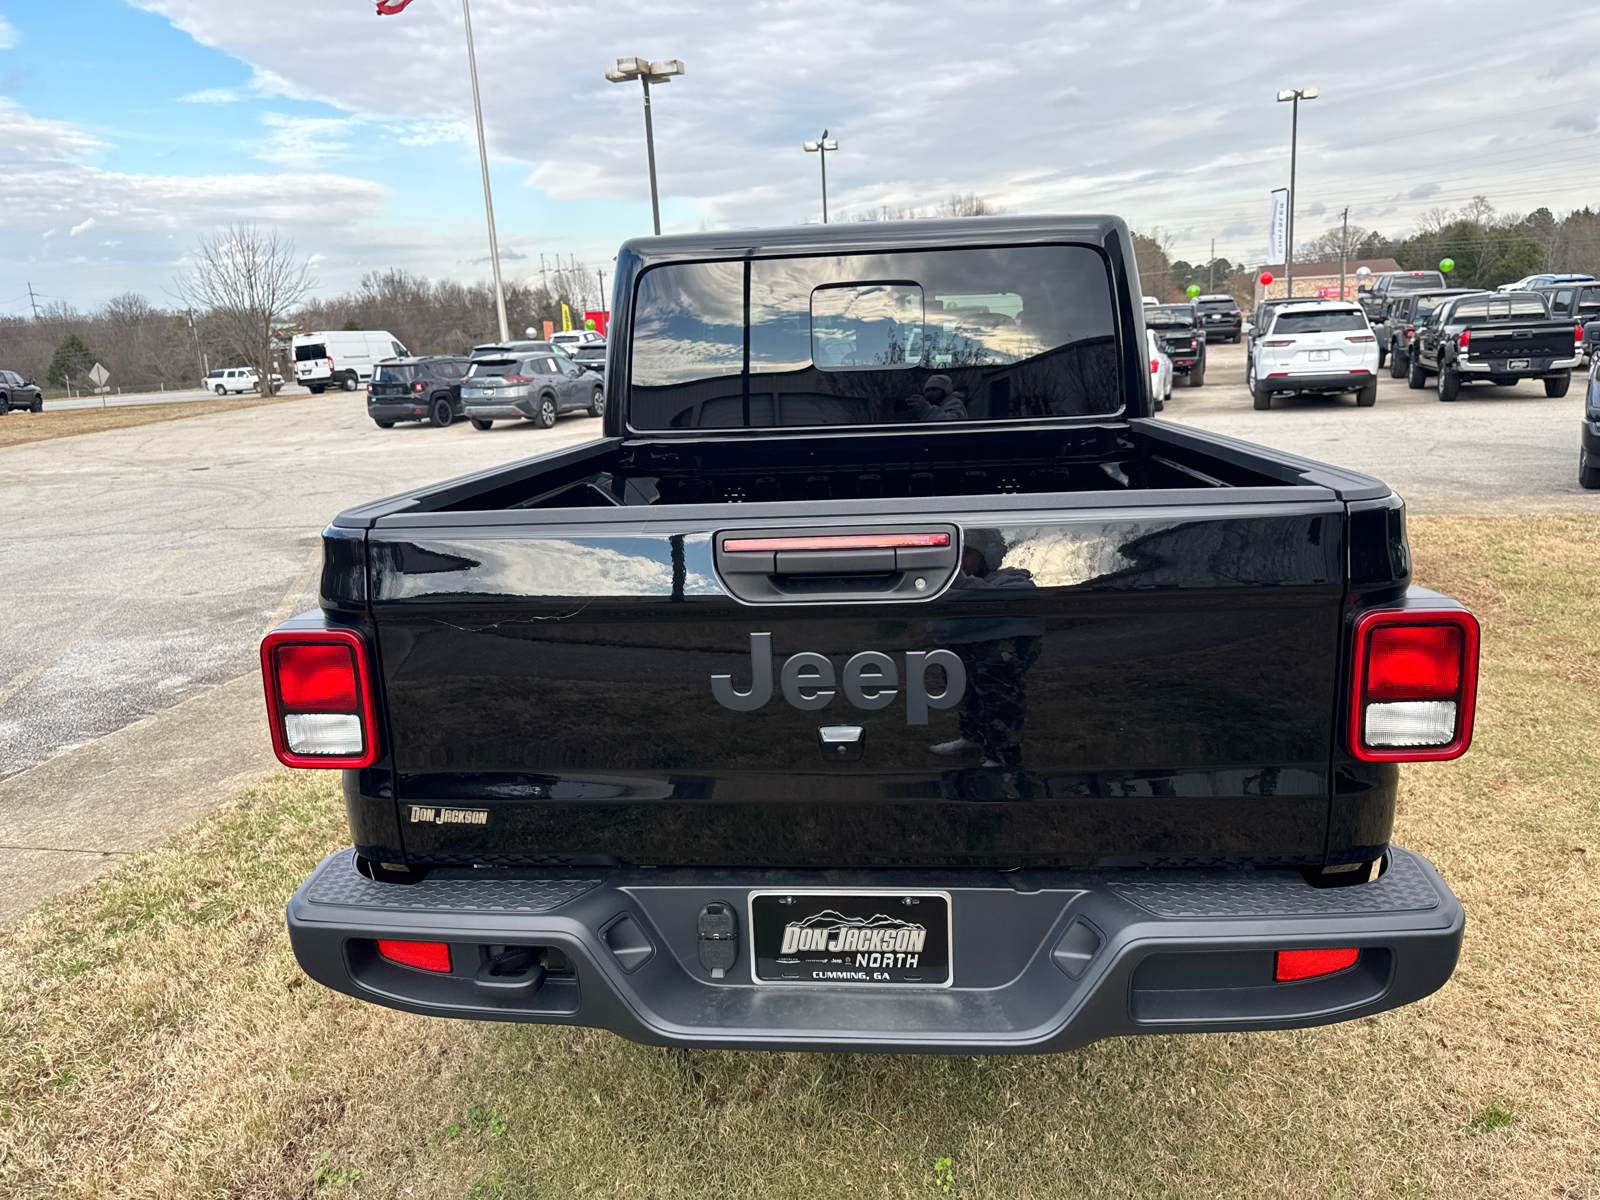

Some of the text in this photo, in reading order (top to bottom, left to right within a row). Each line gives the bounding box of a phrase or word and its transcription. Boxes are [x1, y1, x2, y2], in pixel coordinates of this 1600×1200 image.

[710, 631, 967, 725] Jeep
[410, 806, 488, 825] DON JACKSON
[780, 926, 928, 954] DON JACKSON
[856, 953, 919, 969] NORTH
[812, 971, 891, 981] CUMMING, GA
